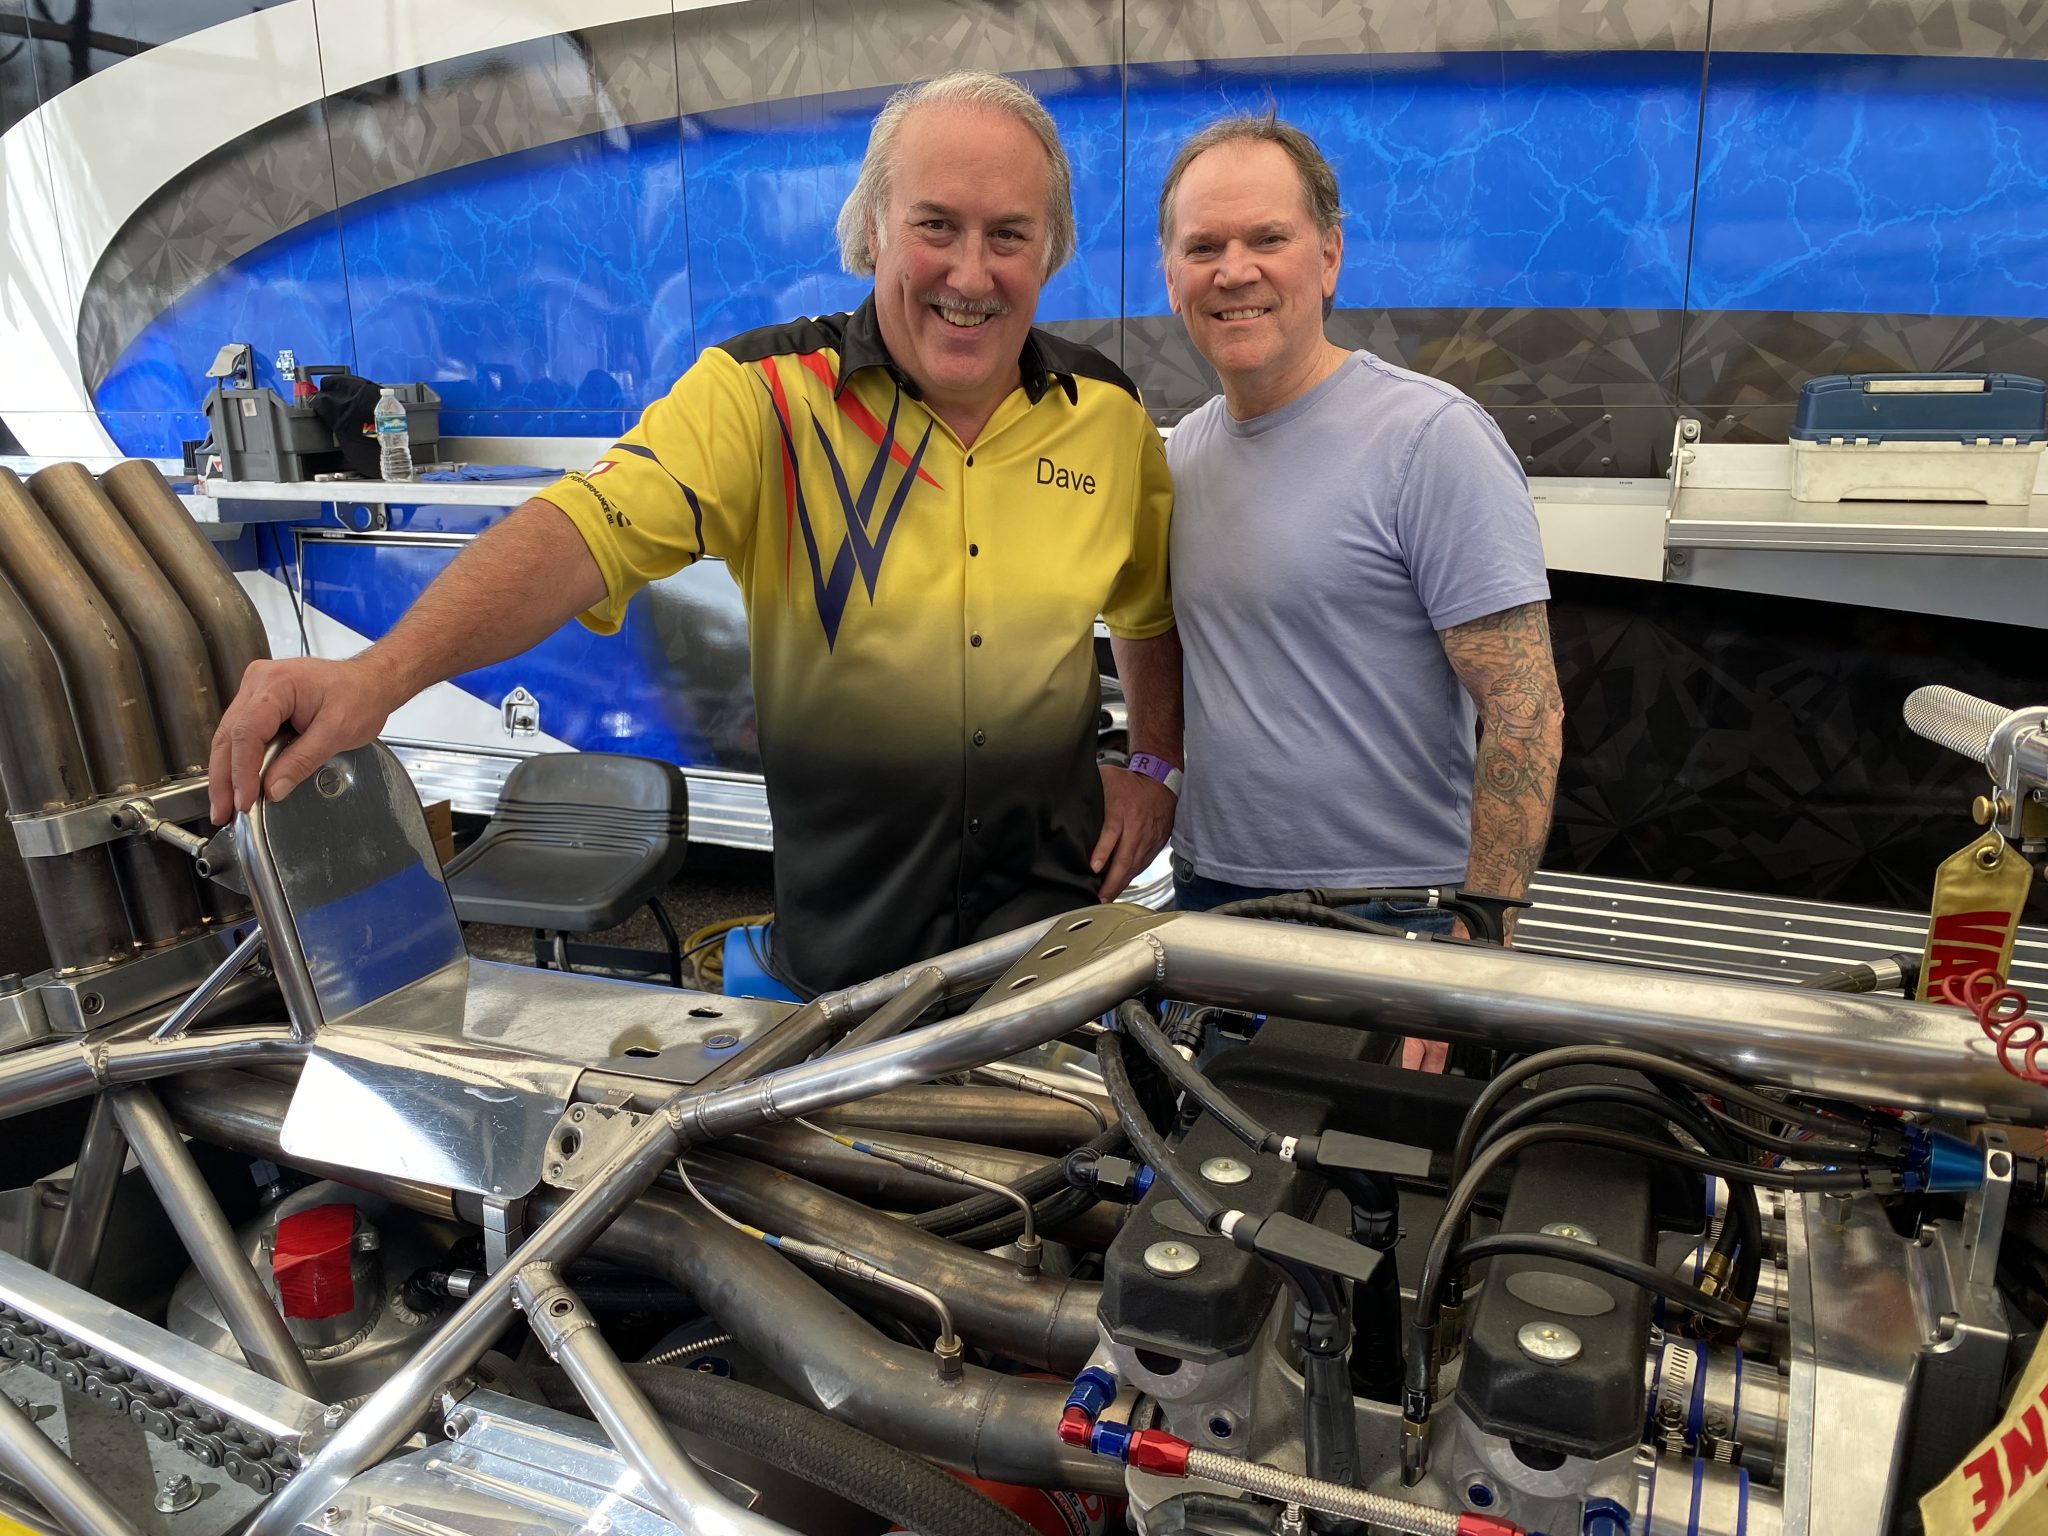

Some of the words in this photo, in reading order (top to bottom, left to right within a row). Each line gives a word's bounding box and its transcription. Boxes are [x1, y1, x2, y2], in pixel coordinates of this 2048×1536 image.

[569, 475, 611, 514] PERFORMANCE
[1037, 457, 1096, 495] Dave
[1963, 1384, 2048, 1533] NE
